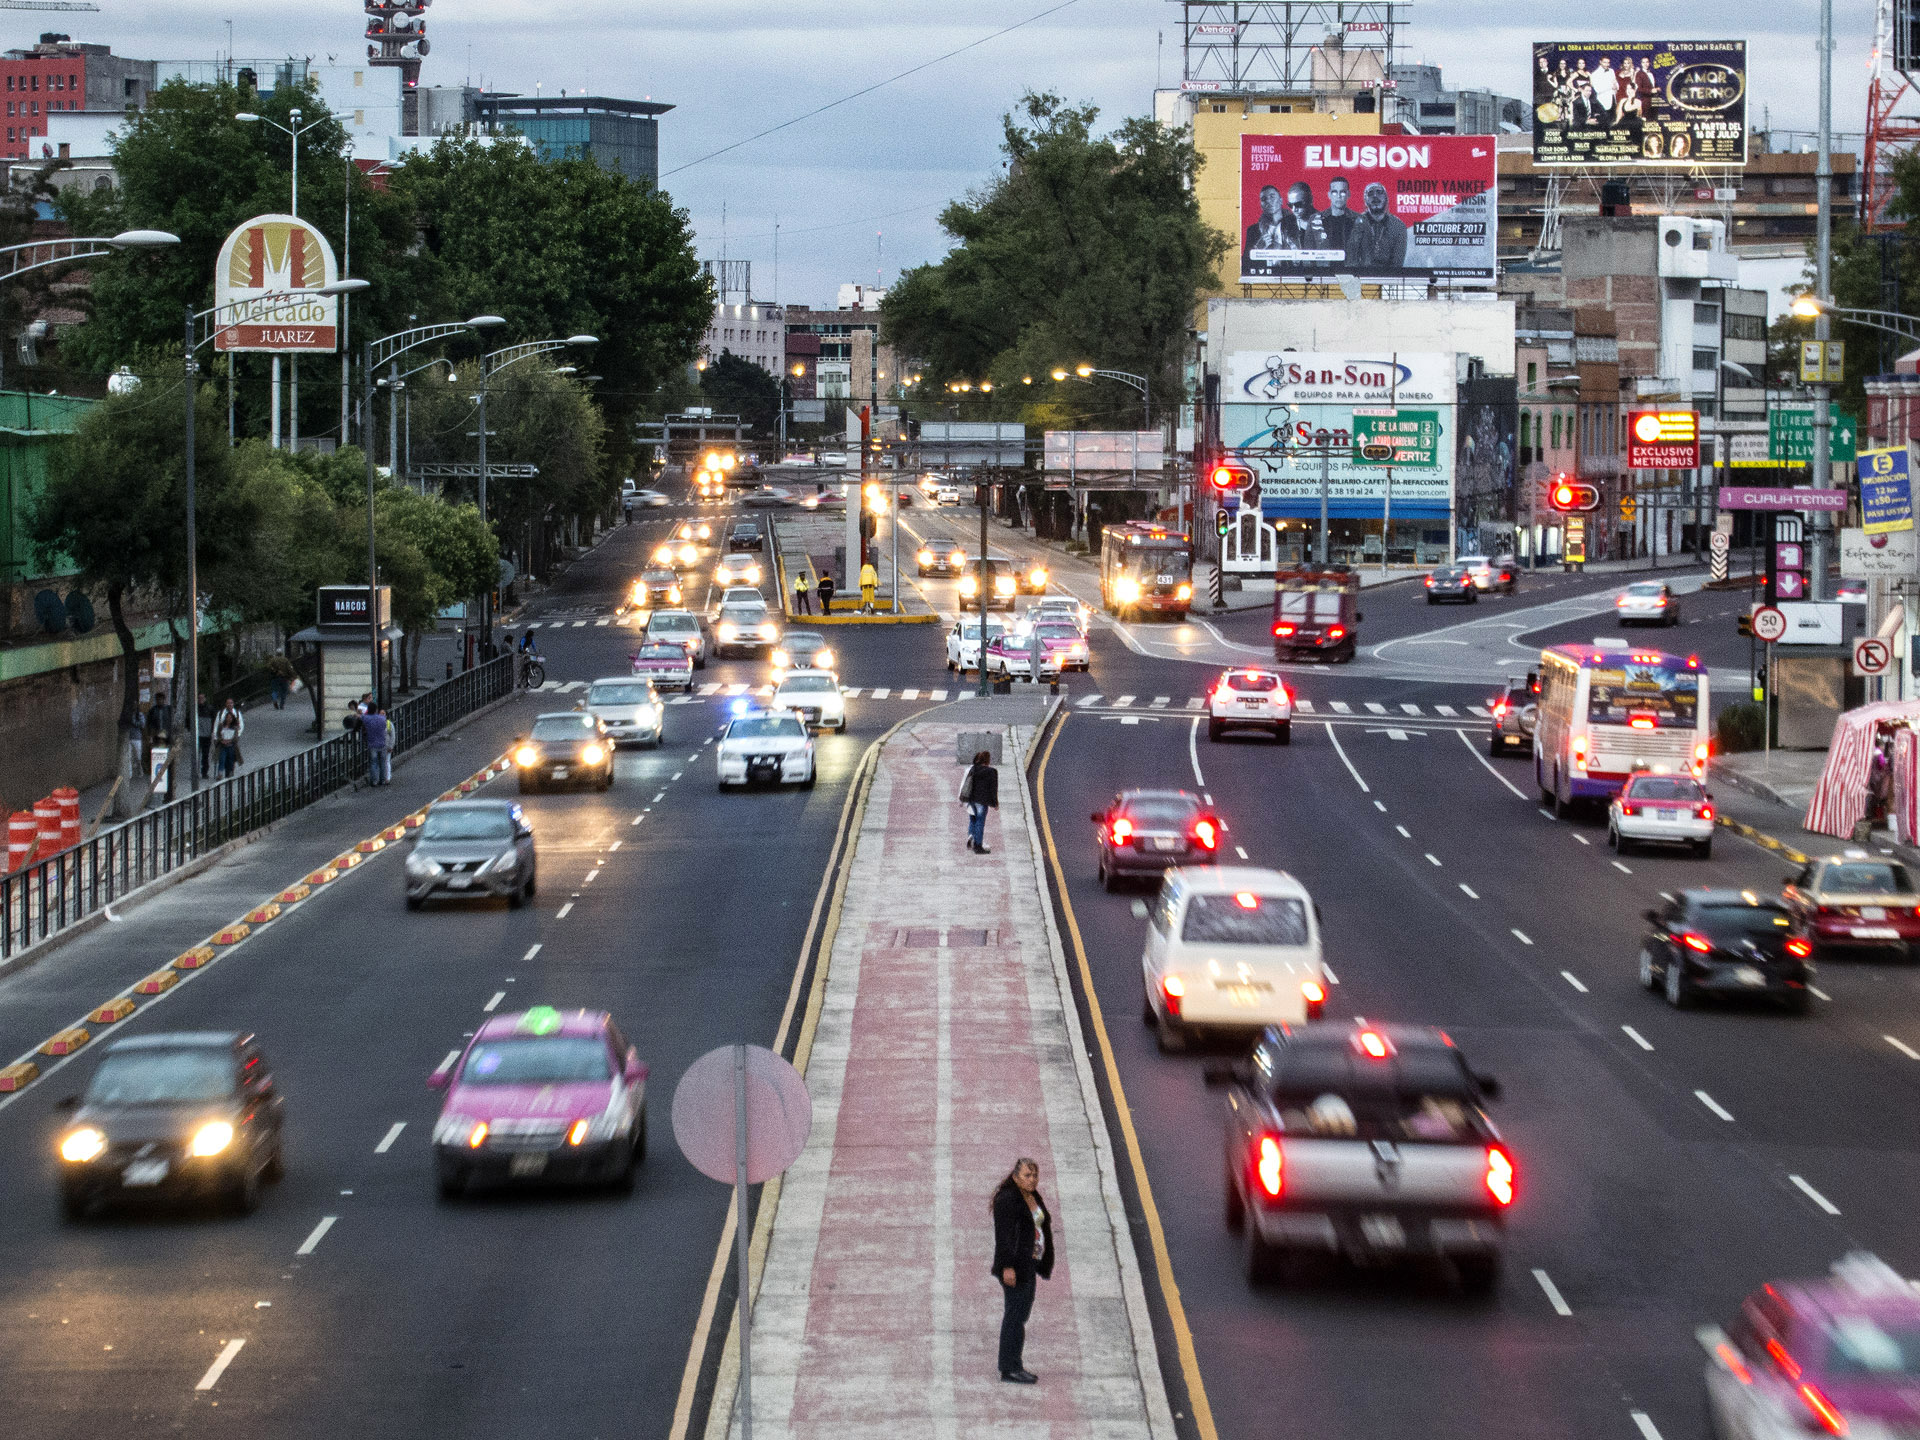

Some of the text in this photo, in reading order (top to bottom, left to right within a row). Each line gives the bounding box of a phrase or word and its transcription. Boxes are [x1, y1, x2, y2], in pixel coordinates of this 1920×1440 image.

[1201, 25, 1233, 34] Vendor
[1349, 23, 1382, 31] 1234-1
[1667, 43, 1733, 51] TEATRO SAN RAFAEL
[1684, 71, 1727, 83] AMOR
[1184, 82, 1217, 91] Vendor
[1680, 87, 1735, 99] ETERNO
[1693, 122, 1742, 131] A PARTIR DEL
[1705, 131, 1716, 139] DE
[1716, 130, 1740, 139] JULIO
[1251, 145, 1275, 154] MUSIC
[1251, 154, 1283, 163] FESTIVAL
[1304, 145, 1430, 169] ELUSION
[1251, 162, 1270, 171] 2017
[1397, 180, 1487, 193] DADDY YANKEE
[1396, 194, 1487, 206] POST MALONE WISIN
[1397, 205, 1418, 214] KEVIN
[1415, 224, 1484, 233] 14 OCTUBRE 2017
[1415, 237, 1431, 245] FORO
[1431, 237, 1453, 245] PEGASO
[227, 299, 326, 322] Mercado
[260, 330, 315, 344] JUAREZ
[1288, 364, 1386, 388] San-Son
[1294, 391, 1434, 400] EQUIPOS PARA GANAR DINERO
[1371, 421, 1376, 432] C
[1378, 422, 1387, 432] DE
[1388, 422, 1398, 432] LA
[1399, 422, 1419, 432] UNION
[1633, 447, 1694, 456] EXCLUSIVO
[1776, 445, 1834, 457] BOLIVR
[1633, 457, 1694, 466] METROBUS
[1877, 455, 1889, 472] E
[1862, 473, 1908, 485] PROMOCIÓN
[1334, 488, 1344, 496] 38
[1346, 488, 1355, 496] 19
[1356, 488, 1363, 496] al
[1364, 488, 1374, 496] 24
[1875, 487, 1886, 495] 12
[1743, 493, 1845, 506] CUAUHTEMOC
[1866, 506, 1911, 518] PASE USTED
[1158, 576, 1172, 584] 431
[334, 600, 367, 612] NARCOS
[1761, 615, 1777, 626] 50
[1760, 626, 1778, 634] km/h
